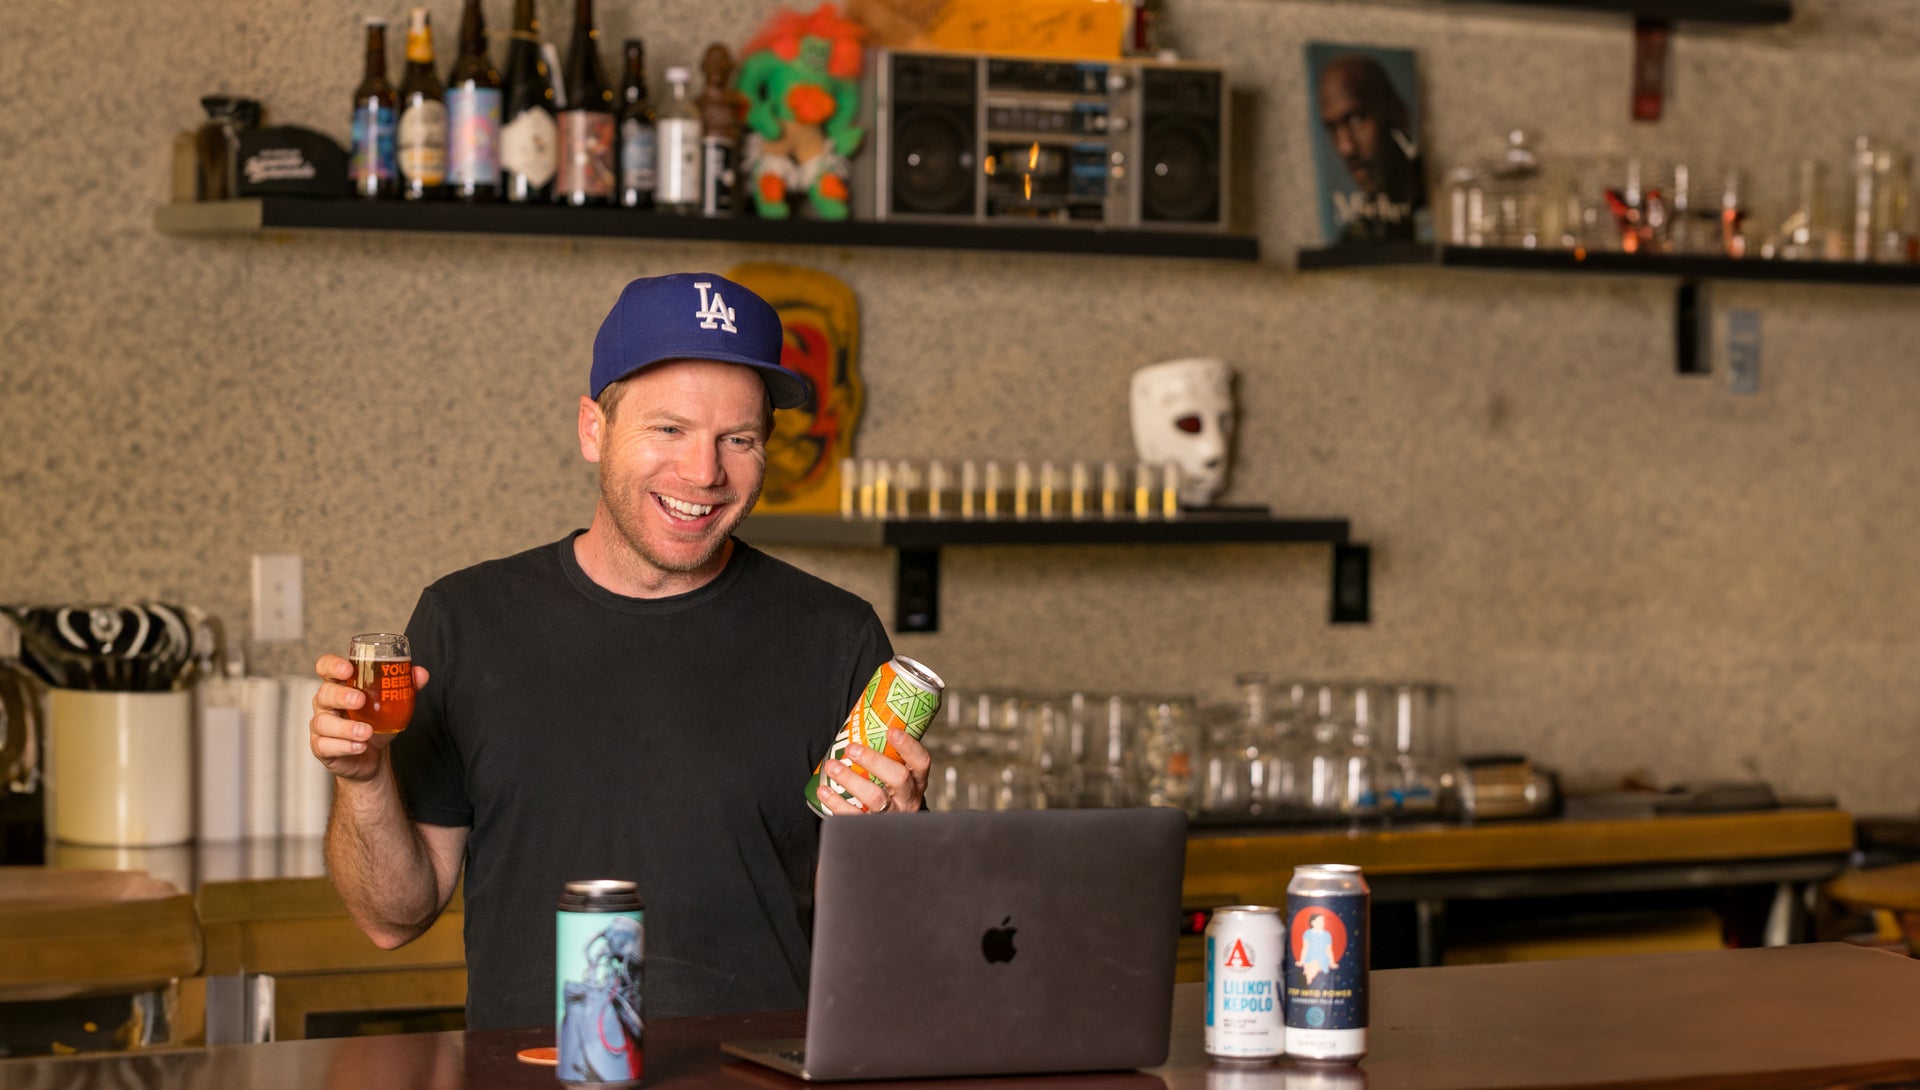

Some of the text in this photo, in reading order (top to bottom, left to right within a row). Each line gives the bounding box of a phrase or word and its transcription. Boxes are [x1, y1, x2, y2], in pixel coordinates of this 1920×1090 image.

[693, 281, 738, 334] LA
[381, 663, 410, 676] YOUR
[381, 675, 411, 688] BEER
[1223, 997, 1273, 1012] KEPOLO
